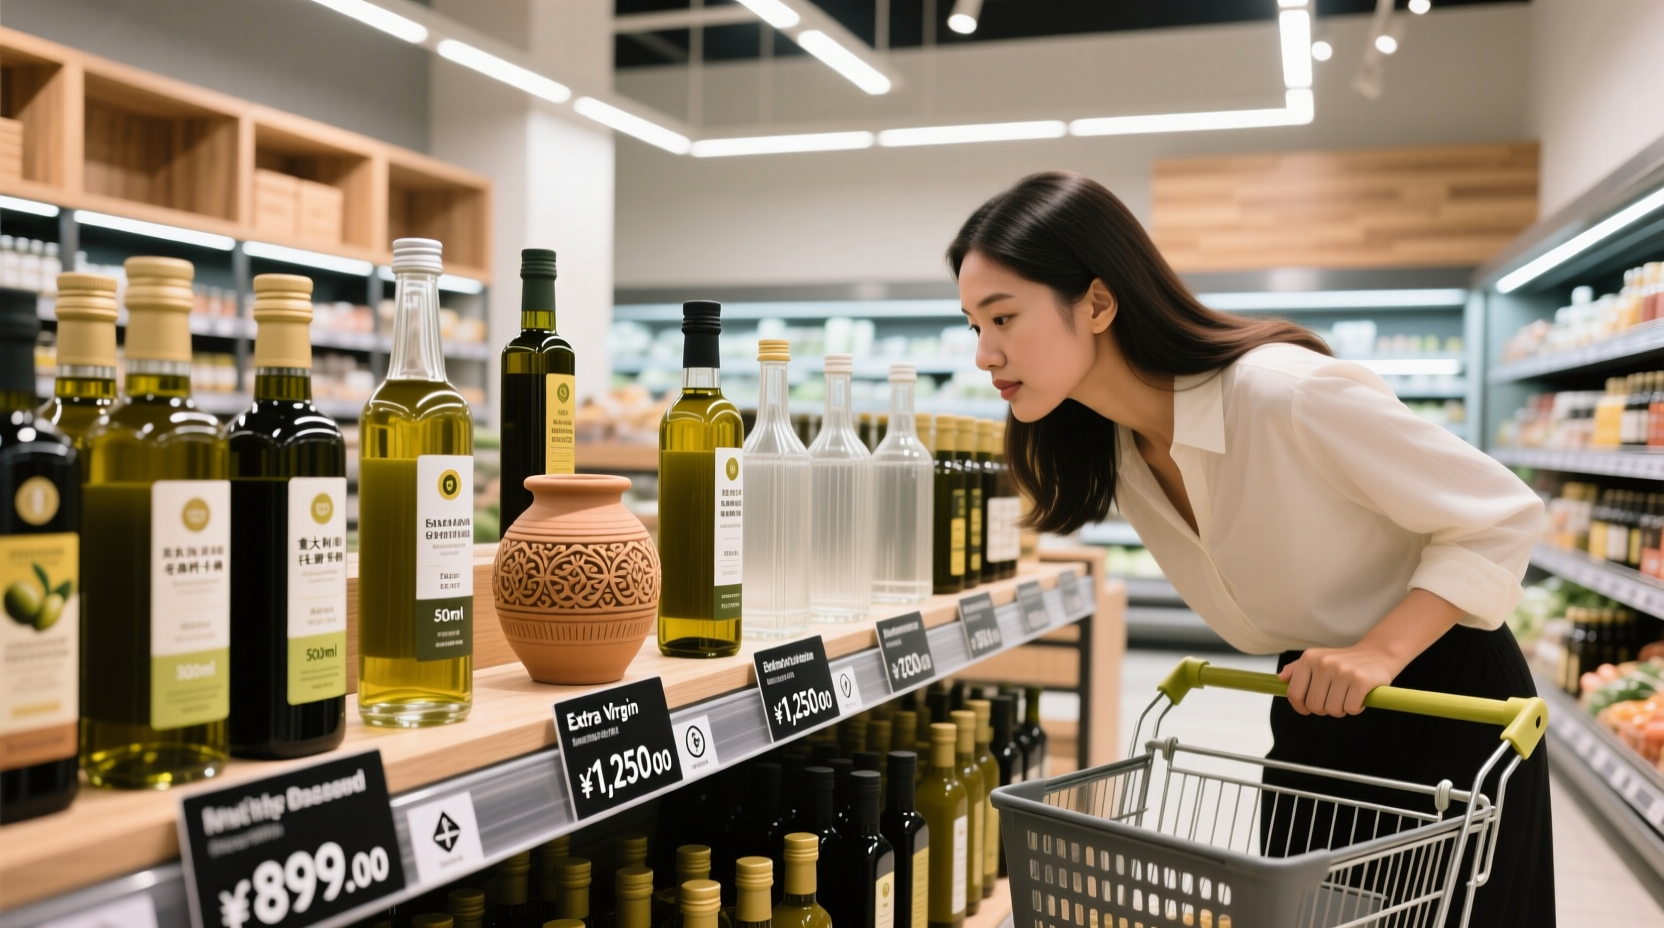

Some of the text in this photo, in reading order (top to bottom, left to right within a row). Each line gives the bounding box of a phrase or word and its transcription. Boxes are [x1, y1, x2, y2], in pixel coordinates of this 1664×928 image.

[434, 606, 464, 623] 50ml
[566, 698, 639, 732] Extra Virgin
[218, 841, 390, 928] ¥899.00
